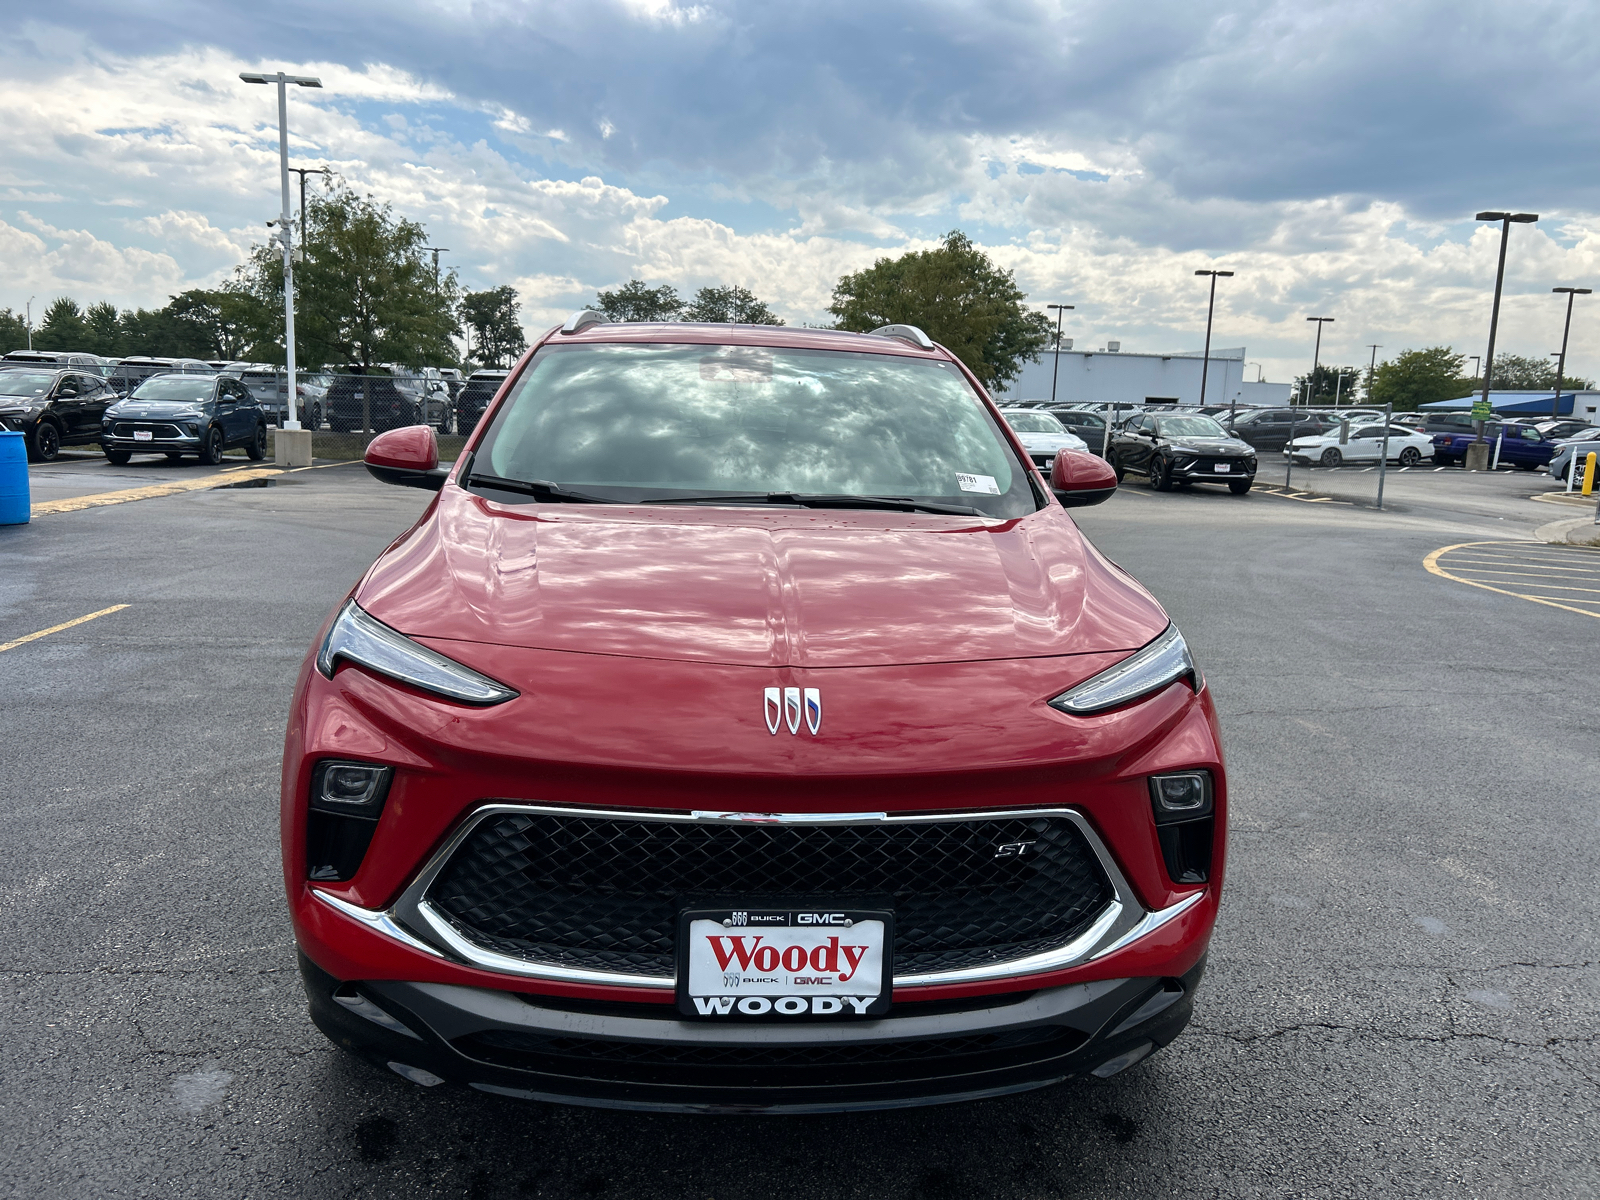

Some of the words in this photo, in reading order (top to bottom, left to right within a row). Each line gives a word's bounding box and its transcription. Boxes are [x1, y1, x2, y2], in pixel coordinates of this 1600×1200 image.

[994, 840, 1037, 858] ST
[797, 913, 845, 924] GMC
[705, 935, 869, 982] Woody
[793, 976, 833, 985] GMC
[692, 996, 878, 1015] WOODY
